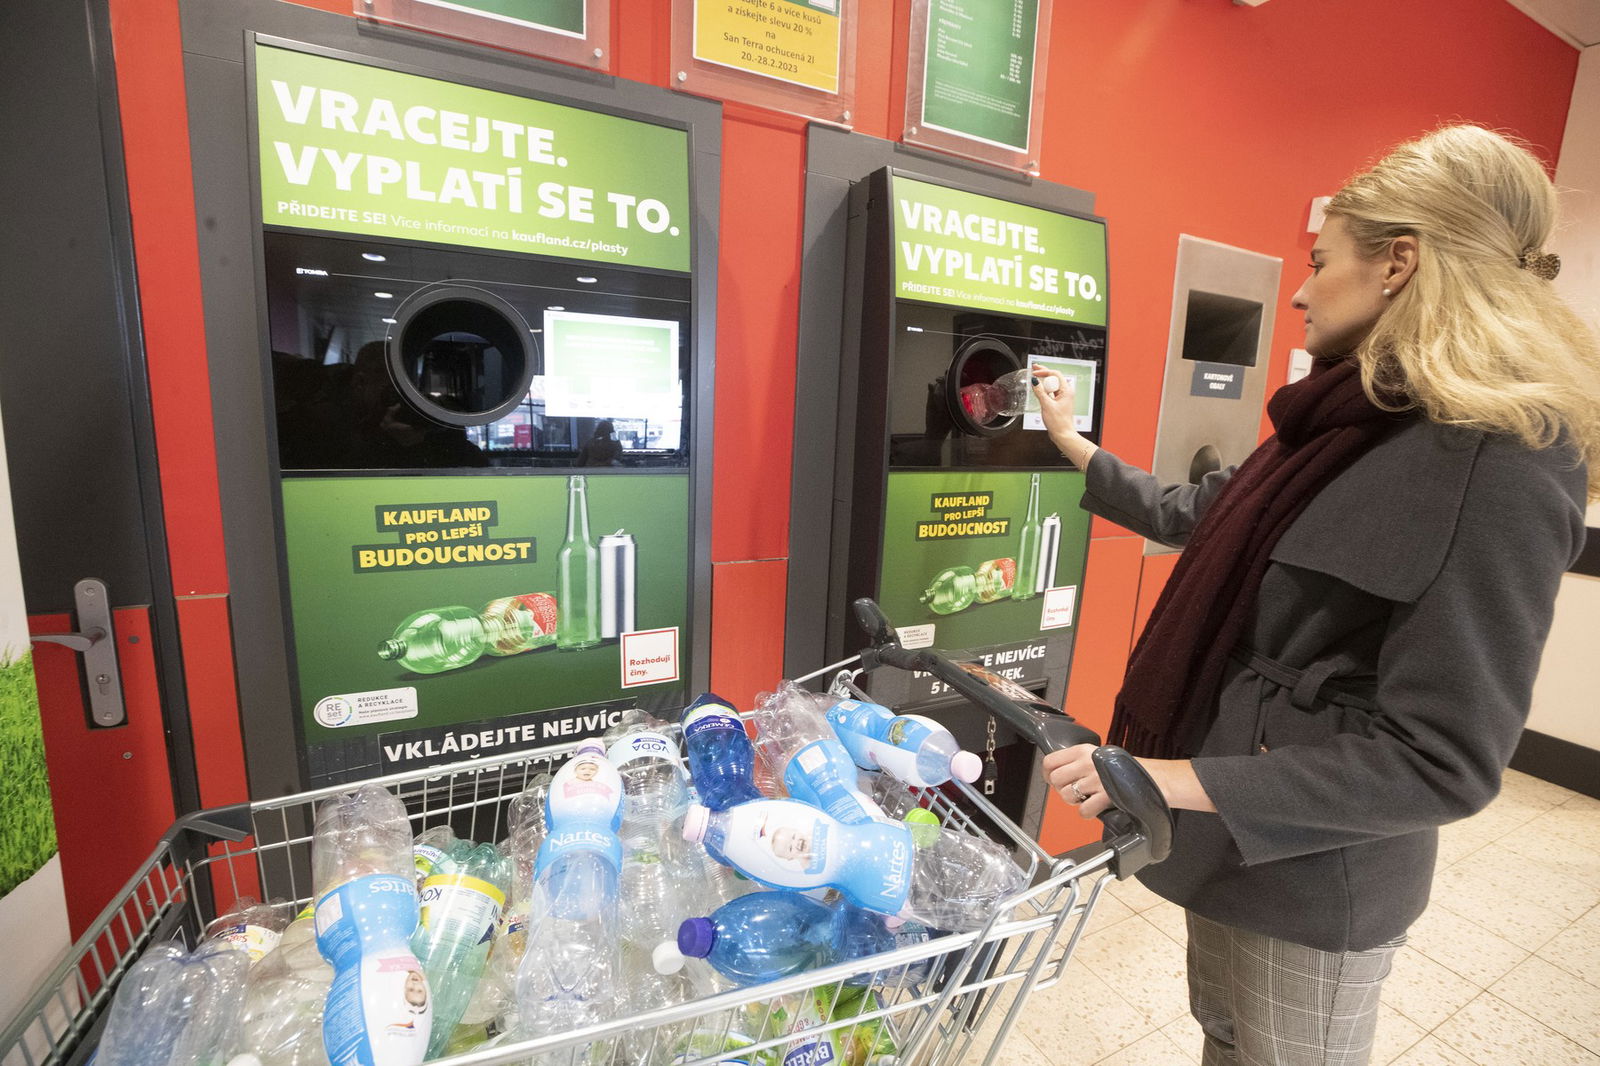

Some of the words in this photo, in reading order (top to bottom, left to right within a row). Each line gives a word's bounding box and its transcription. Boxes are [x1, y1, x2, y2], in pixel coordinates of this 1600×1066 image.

[727, 5, 733, 13] a
[735, 7, 768, 23] získejte
[769, 16, 791, 30] slevu
[793, 23, 804, 33] 20
[805, 27, 812, 36] %
[770, 2, 775, 10] 6
[784, 7, 801, 18] více
[803, 12, 821, 24] kusů
[765, 31, 776, 39] na
[724, 32, 740, 44] San
[742, 37, 763, 50] Terra
[766, 45, 805, 61] ochucená
[741, 51, 798, 73] 20.-28.2.2023
[271, 79, 568, 167] VRACEJTE.
[274, 141, 522, 213] VYPLATÍ
[538, 182, 594, 224] SE
[607, 190, 680, 237] TO.
[277, 200, 358, 222] PŘIDEJTE
[362, 210, 387, 225] SE!
[391, 215, 421, 230] Více
[425, 219, 489, 237] informací
[492, 229, 508, 240] na
[512, 229, 629, 256] kaufland.cz/plasty
[900, 199, 1045, 254] VRACEJTE.
[901, 241, 1023, 288] VYPLATÍ
[1029, 265, 1058, 294] SE
[1064, 271, 1102, 302] TO.
[902, 281, 941, 296] PŘIDEJTE
[934, 495, 990, 508] KAUFLAND
[383, 507, 491, 526] KAUFLAND
[944, 511, 962, 521] PRO
[963, 507, 984, 519] LEPŠÍ
[405, 530, 439, 544] PRO
[442, 523, 483, 541] LEPŠÍ
[919, 521, 1009, 538] BUDOUCNOST
[359, 542, 532, 568] BUDOUCNOST
[629, 655, 671, 667] Rozhodují
[995, 645, 1047, 665] NEJVÍCE
[630, 669, 648, 677] činy.
[931, 682, 940, 694] 5
[326, 703, 342, 712] RE
[357, 695, 388, 703] REDUKCE
[365, 698, 403, 707] RECYKLACE
[383, 724, 536, 763] VKLÁDEJTE
[632, 743, 670, 754] VODA
[550, 830, 612, 851] Nartes
[880, 840, 906, 899] Nartes
[369, 880, 416, 897] artes
